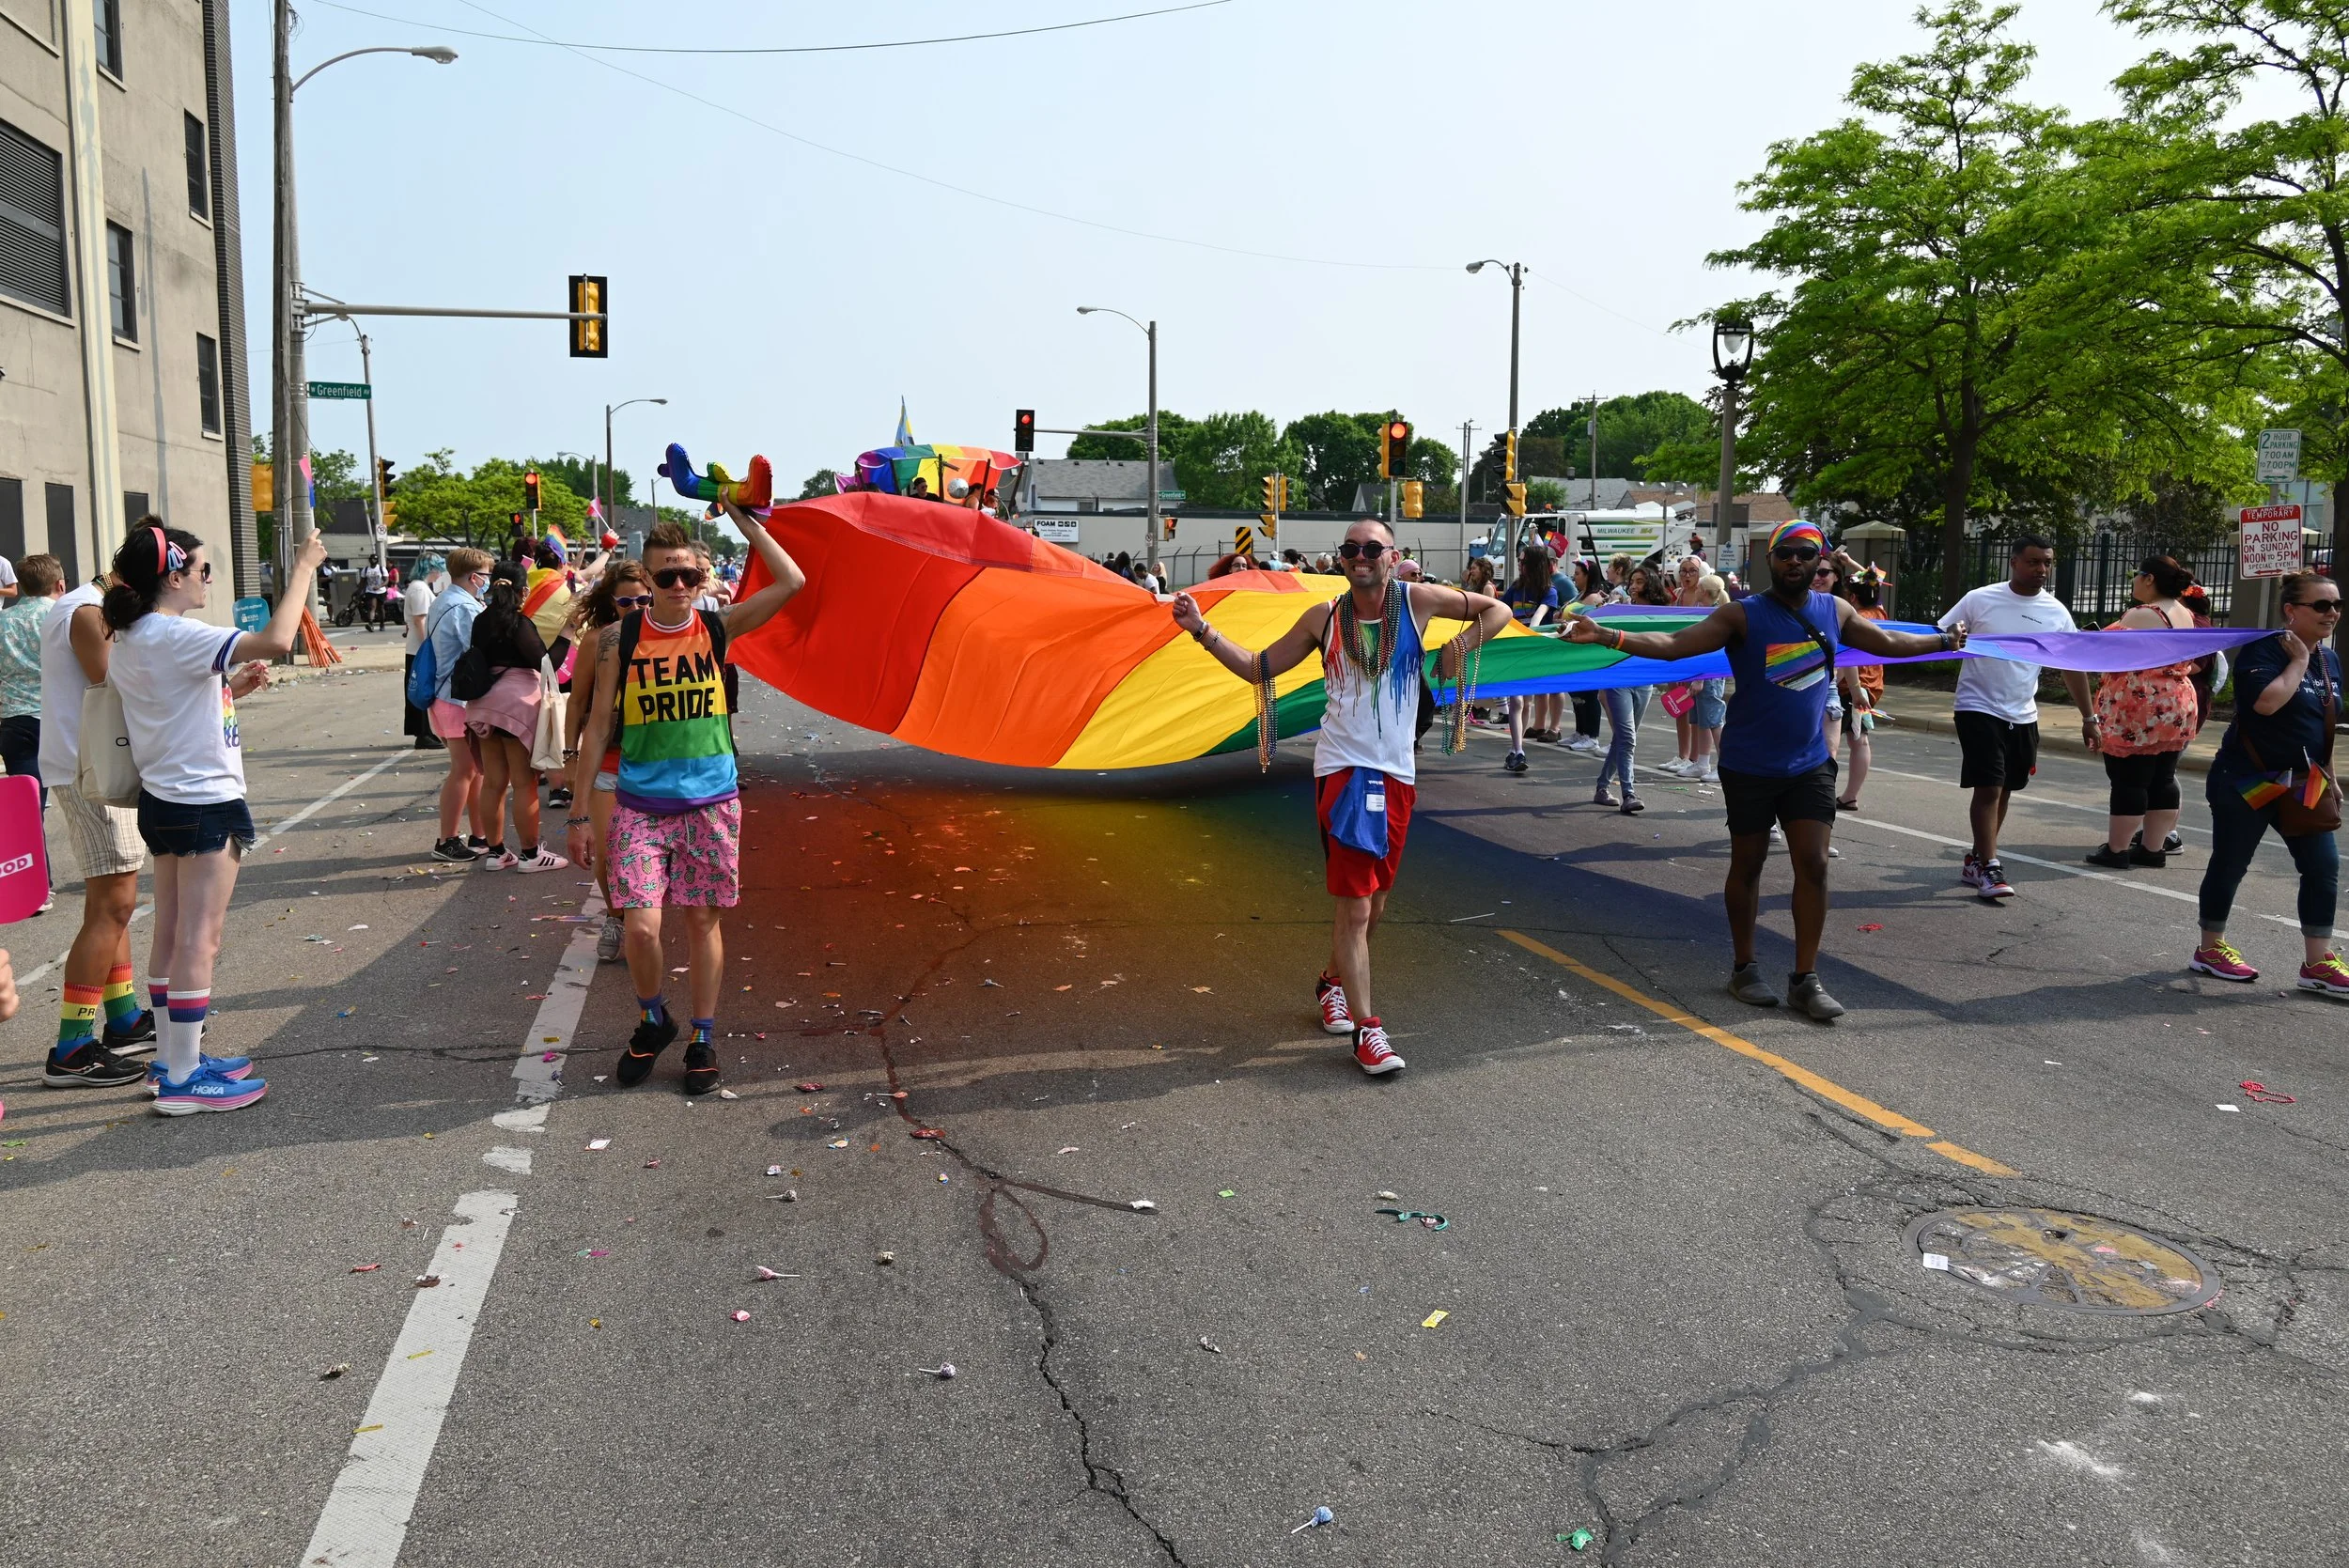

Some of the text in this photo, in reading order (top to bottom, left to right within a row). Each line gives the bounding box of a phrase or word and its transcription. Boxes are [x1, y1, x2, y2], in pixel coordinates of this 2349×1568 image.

[317, 384, 363, 397] Greenfield
[2262, 433, 2271, 449] 2
[2246, 510, 2294, 520] TEMPORARY
[2262, 522, 2279, 533] NO
[2245, 531, 2298, 544] PARKING
[2244, 541, 2294, 553] ON SUNDAY
[2244, 553, 2266, 564] NOON
[2277, 551, 2298, 561] 5PM
[631, 651, 716, 690] TEAM
[637, 687, 715, 725] PRIDE
[0, 857, 28, 874] OD
[191, 1085, 225, 1094] HOKA
